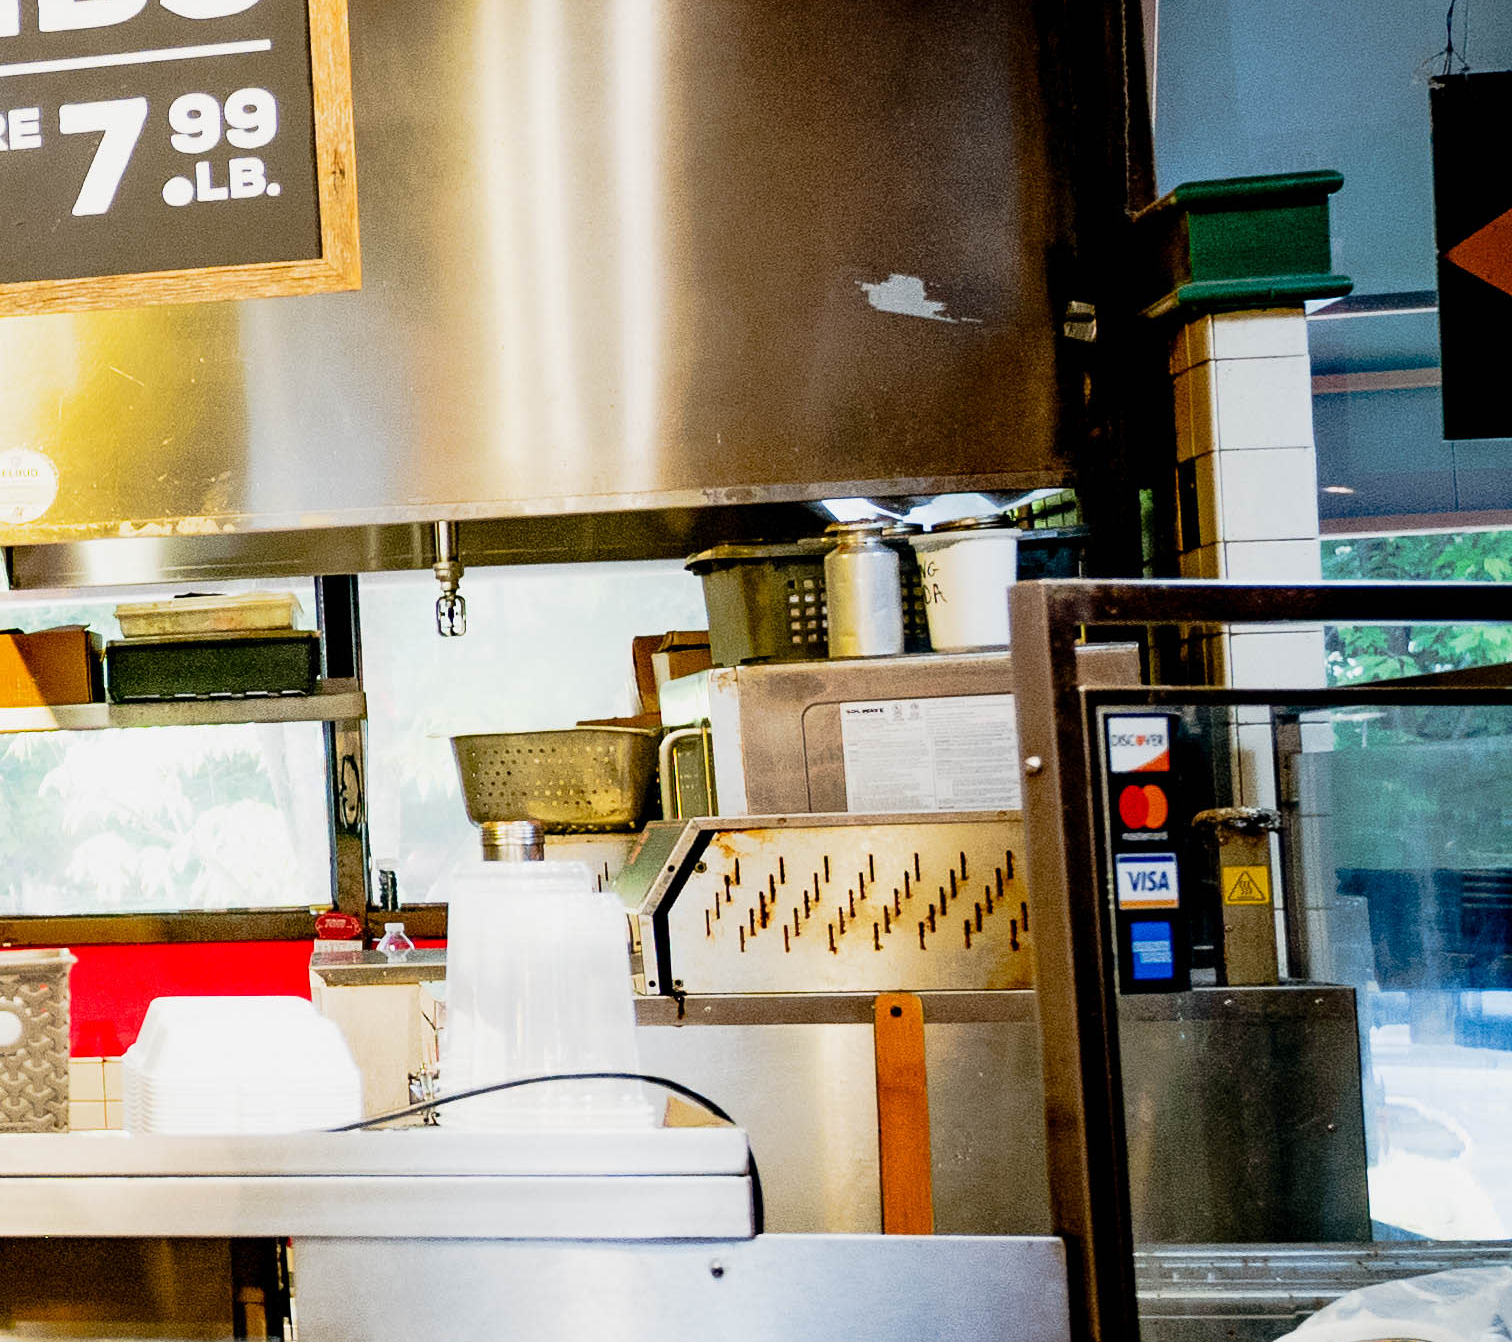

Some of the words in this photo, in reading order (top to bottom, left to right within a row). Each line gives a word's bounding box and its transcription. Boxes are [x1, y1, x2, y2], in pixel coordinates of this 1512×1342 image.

[57, 96, 148, 218] 7
[168, 86, 277, 153] 99
[1128, 871, 1171, 891] VISA
